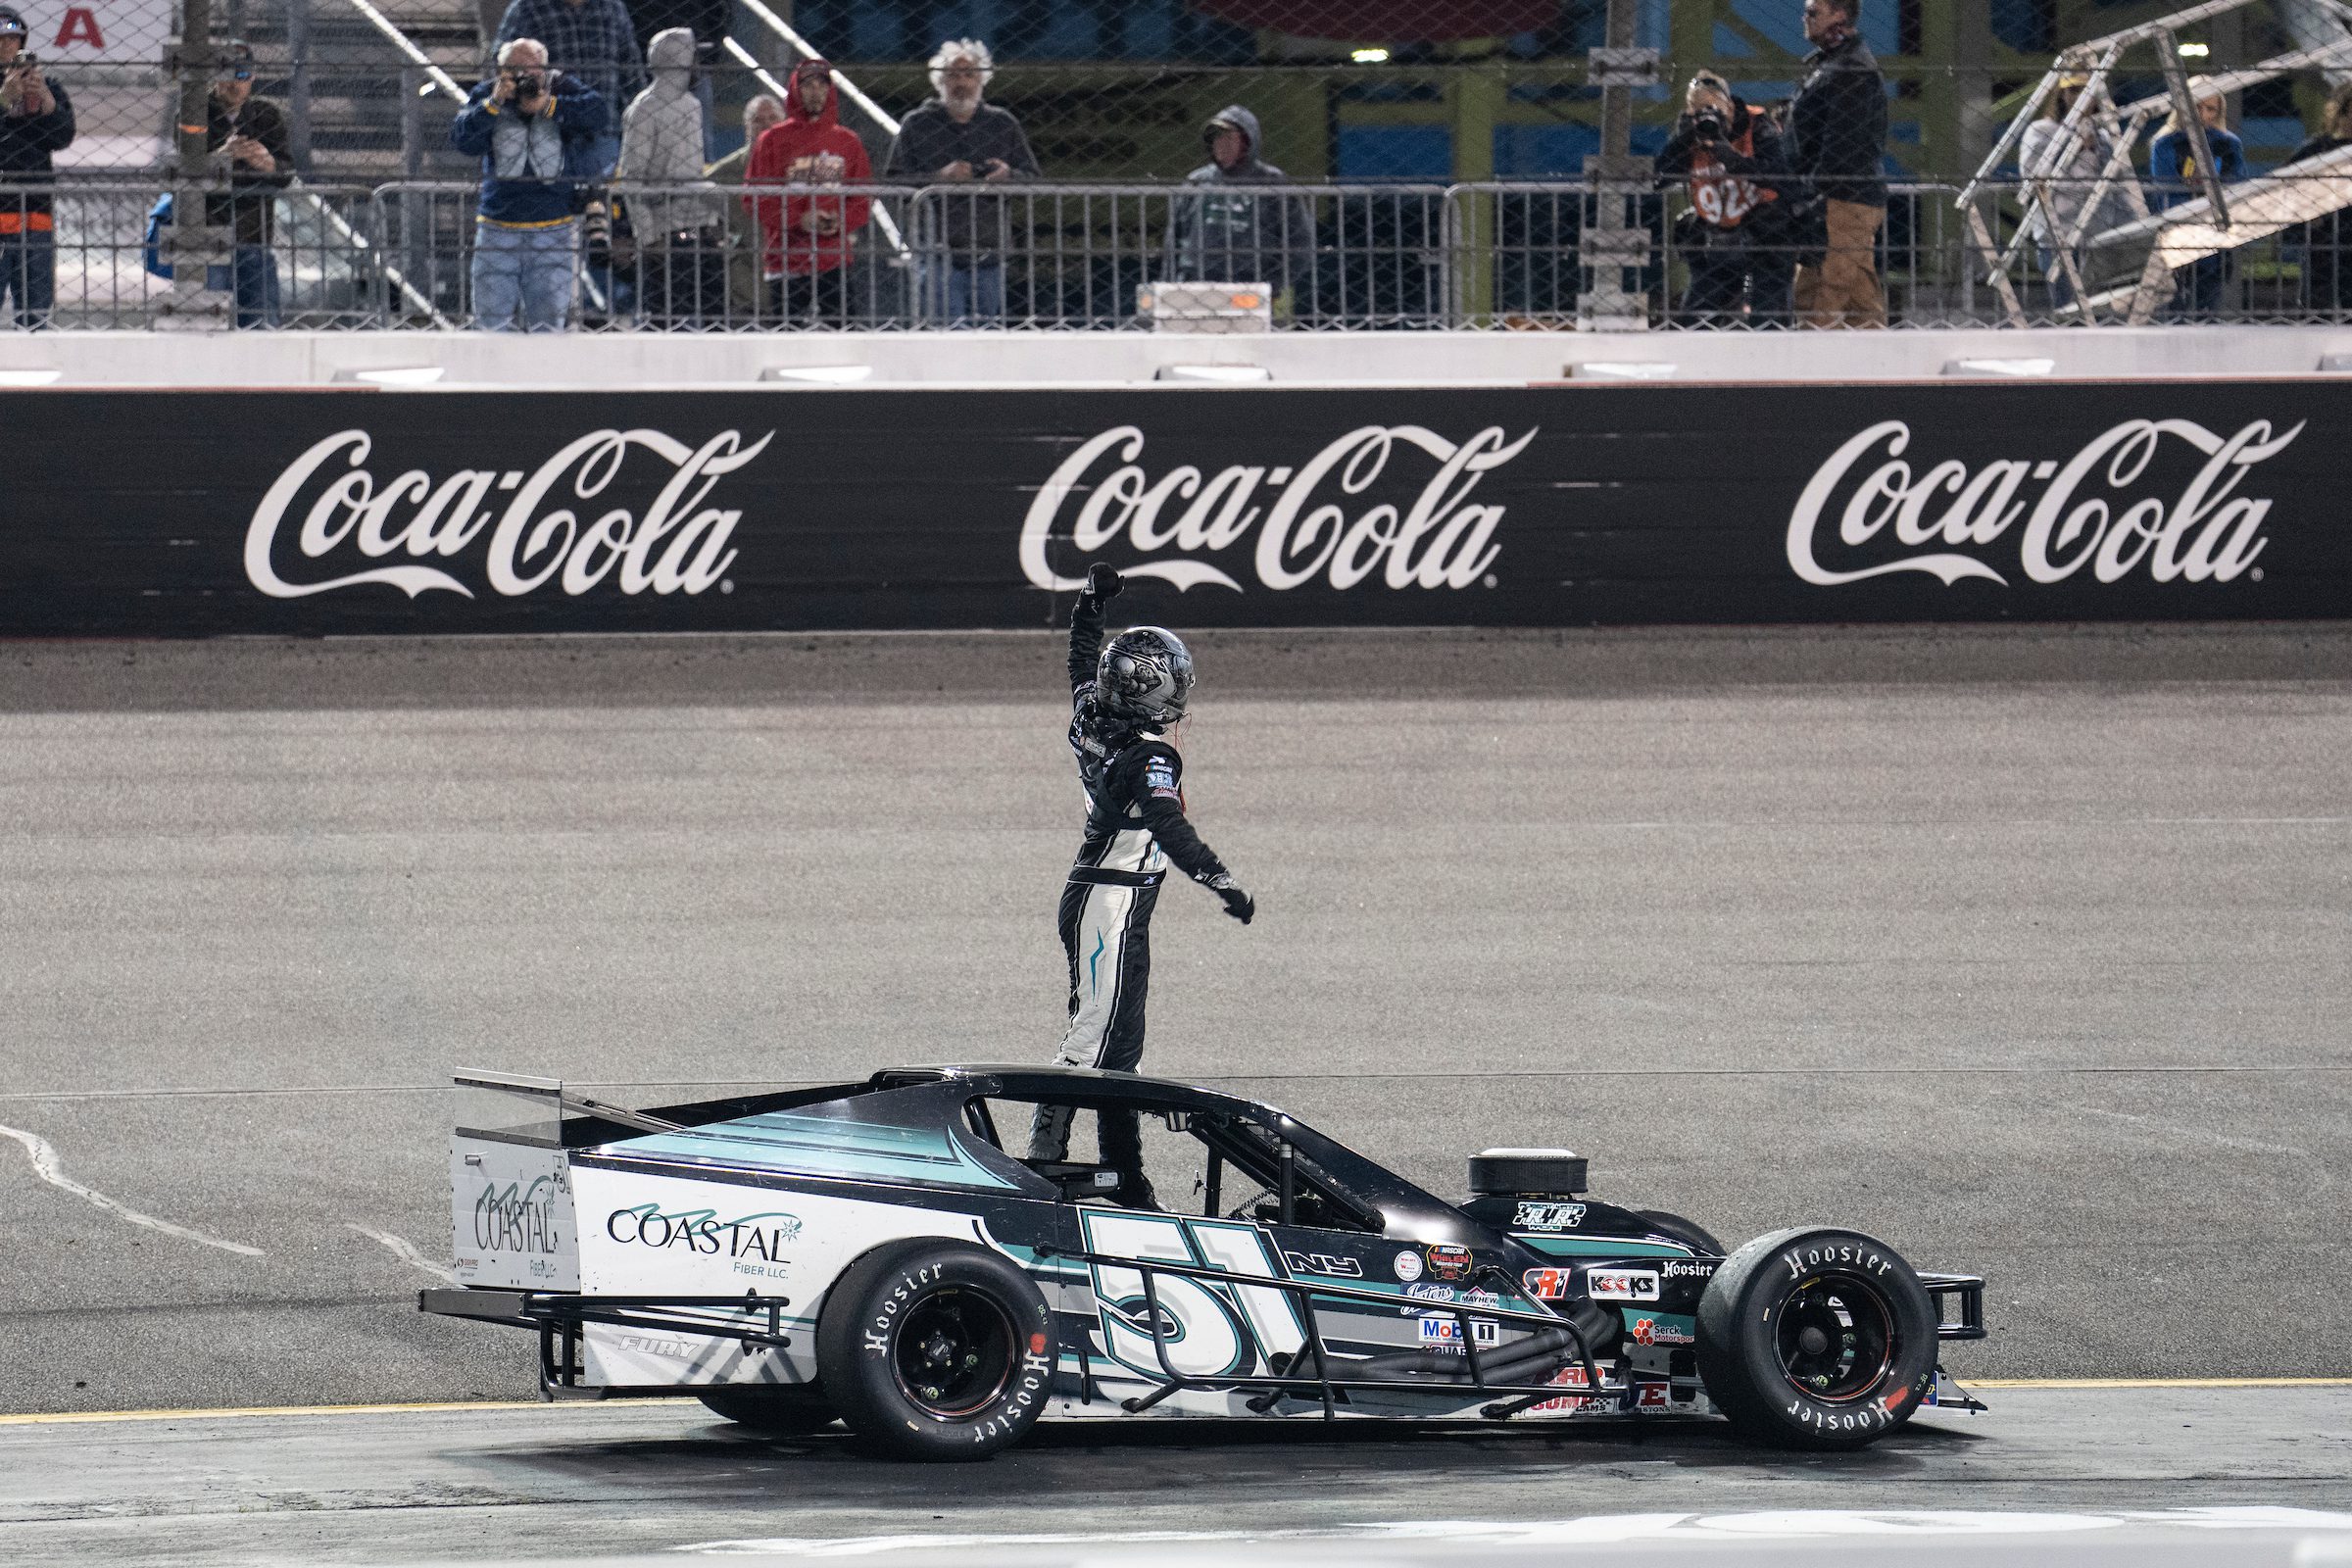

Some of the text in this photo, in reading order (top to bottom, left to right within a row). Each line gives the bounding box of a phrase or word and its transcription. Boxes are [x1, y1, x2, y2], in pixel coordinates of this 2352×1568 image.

[53, 8, 105, 49] A
[244, 429, 776, 599] Coca-Cola
[1018, 424, 1540, 593] Coca-Cola
[1786, 418, 2308, 587] Coca-Cola
[474, 1198, 555, 1253] COASTAL
[607, 1209, 792, 1264] COASTAL
[733, 1261, 789, 1280] FIBER LLC.
[1284, 1250, 1363, 1277] NY
[1430, 1253, 1469, 1263] WHELEN
[1660, 1261, 1713, 1278] Hoosier
[1783, 1243, 1892, 1281] Hoosier
[1078, 1206, 1308, 1381] 51
[1461, 1295, 1497, 1304] MAYHEW
[1591, 1276, 1654, 1298] KOOKS
[864, 1263, 942, 1357] Hoosier
[1424, 1320, 1474, 1339] Mob
[1654, 1325, 1681, 1335] Serck
[1654, 1334, 1694, 1344] Motorspor
[617, 1335, 700, 1358] FURY
[1548, 1368, 1604, 1385] RP
[974, 1348, 1051, 1443] Hoosier
[1787, 1396, 1894, 1434] Hoosier
